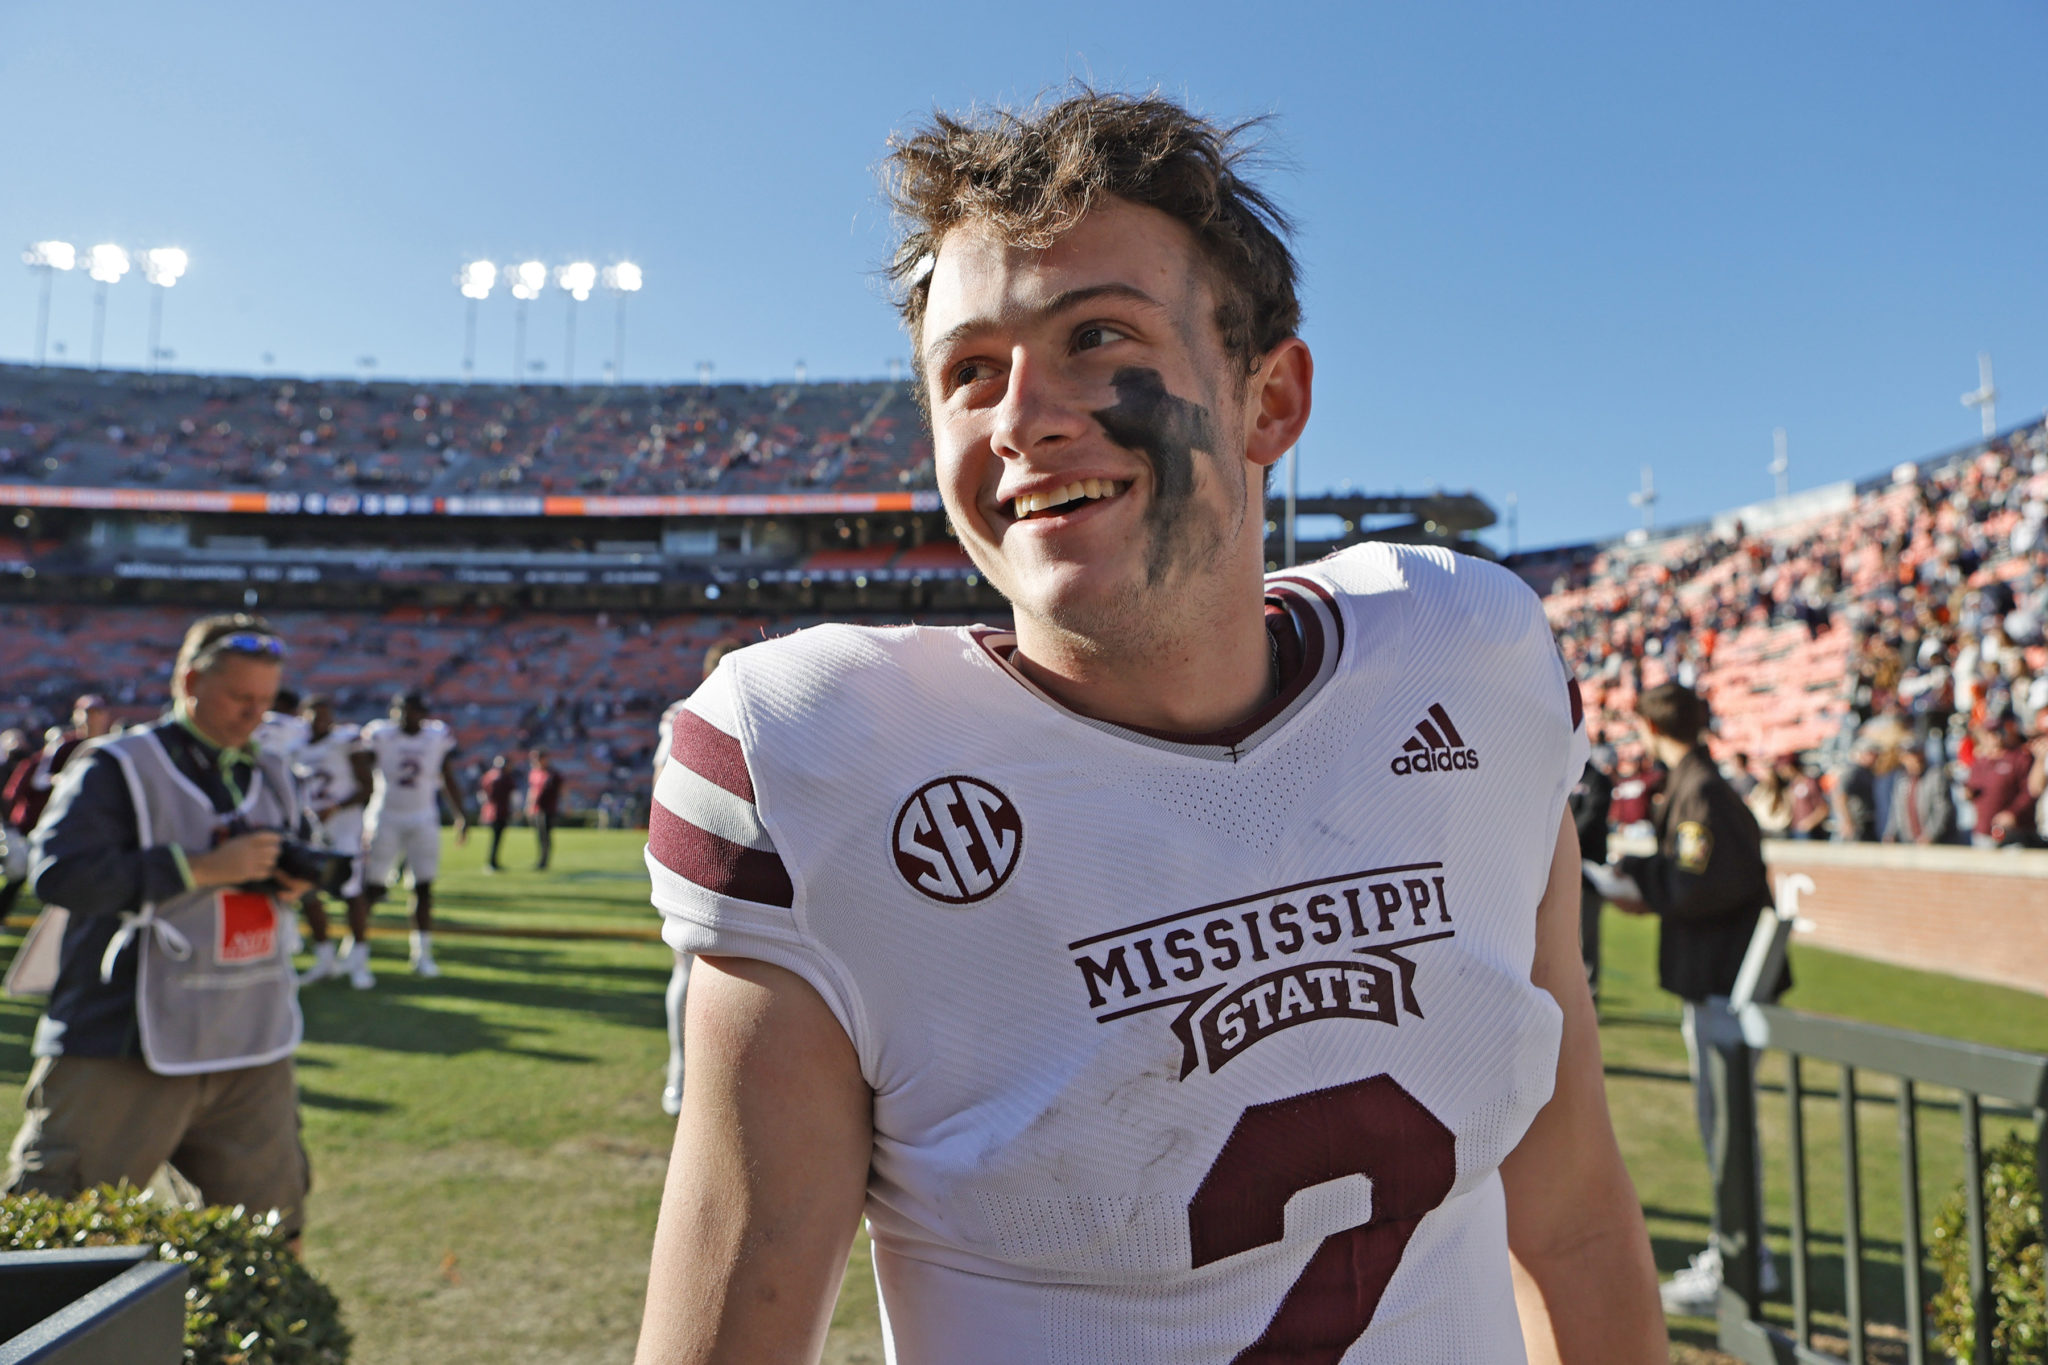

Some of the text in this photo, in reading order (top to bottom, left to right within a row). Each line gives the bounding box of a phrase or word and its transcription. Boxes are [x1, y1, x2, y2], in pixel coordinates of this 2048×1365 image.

[1391, 746, 1479, 775] adidas
[898, 780, 1016, 898] SEC
[1075, 876, 1452, 1008] MISSISSIPPI
[1216, 967, 1379, 1050] STATE
[1187, 1072, 1457, 1365] 2
